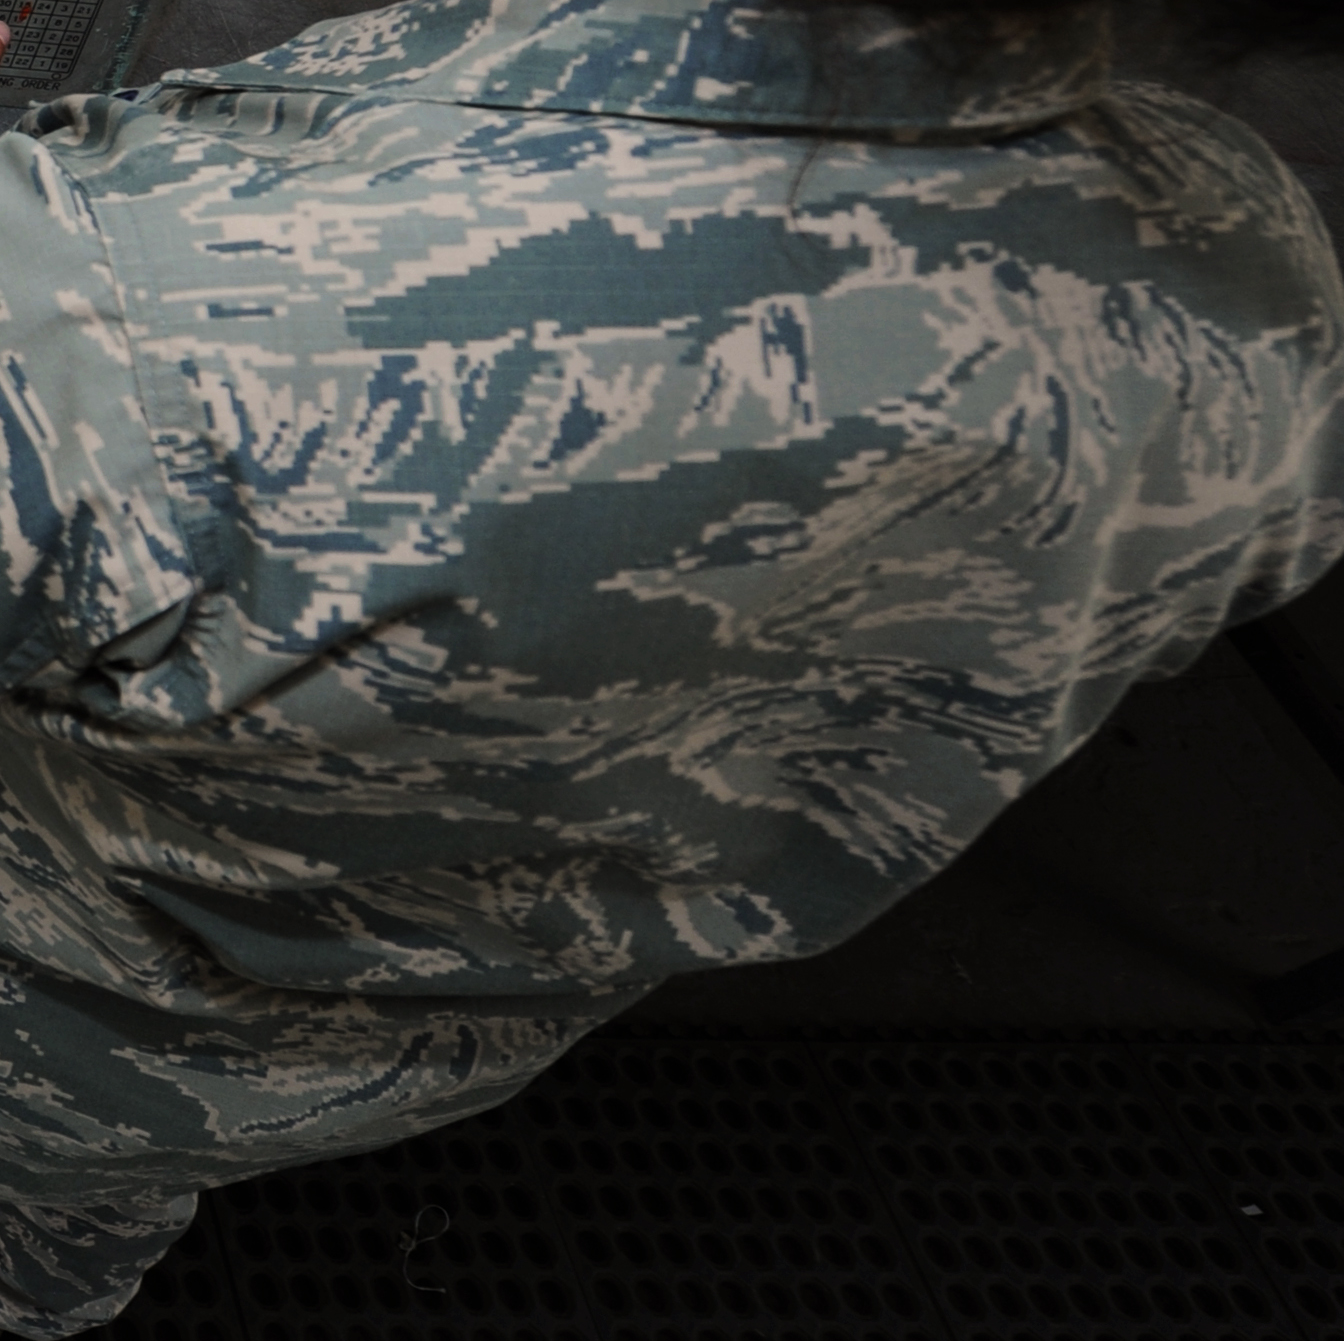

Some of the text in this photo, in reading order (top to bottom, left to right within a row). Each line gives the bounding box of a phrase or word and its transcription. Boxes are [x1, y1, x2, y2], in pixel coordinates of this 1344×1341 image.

[37, 3, 51, 11] 24
[77, 7, 91, 15] 21
[32, 17, 46, 25] 11
[26, 31, 40, 39] 23
[65, 35, 80, 43] 20
[22, 44, 35, 52] 10
[15, 58, 30, 66] 22
[55, 61, 69, 69] 19
[21, 78, 62, 91] ORDER
